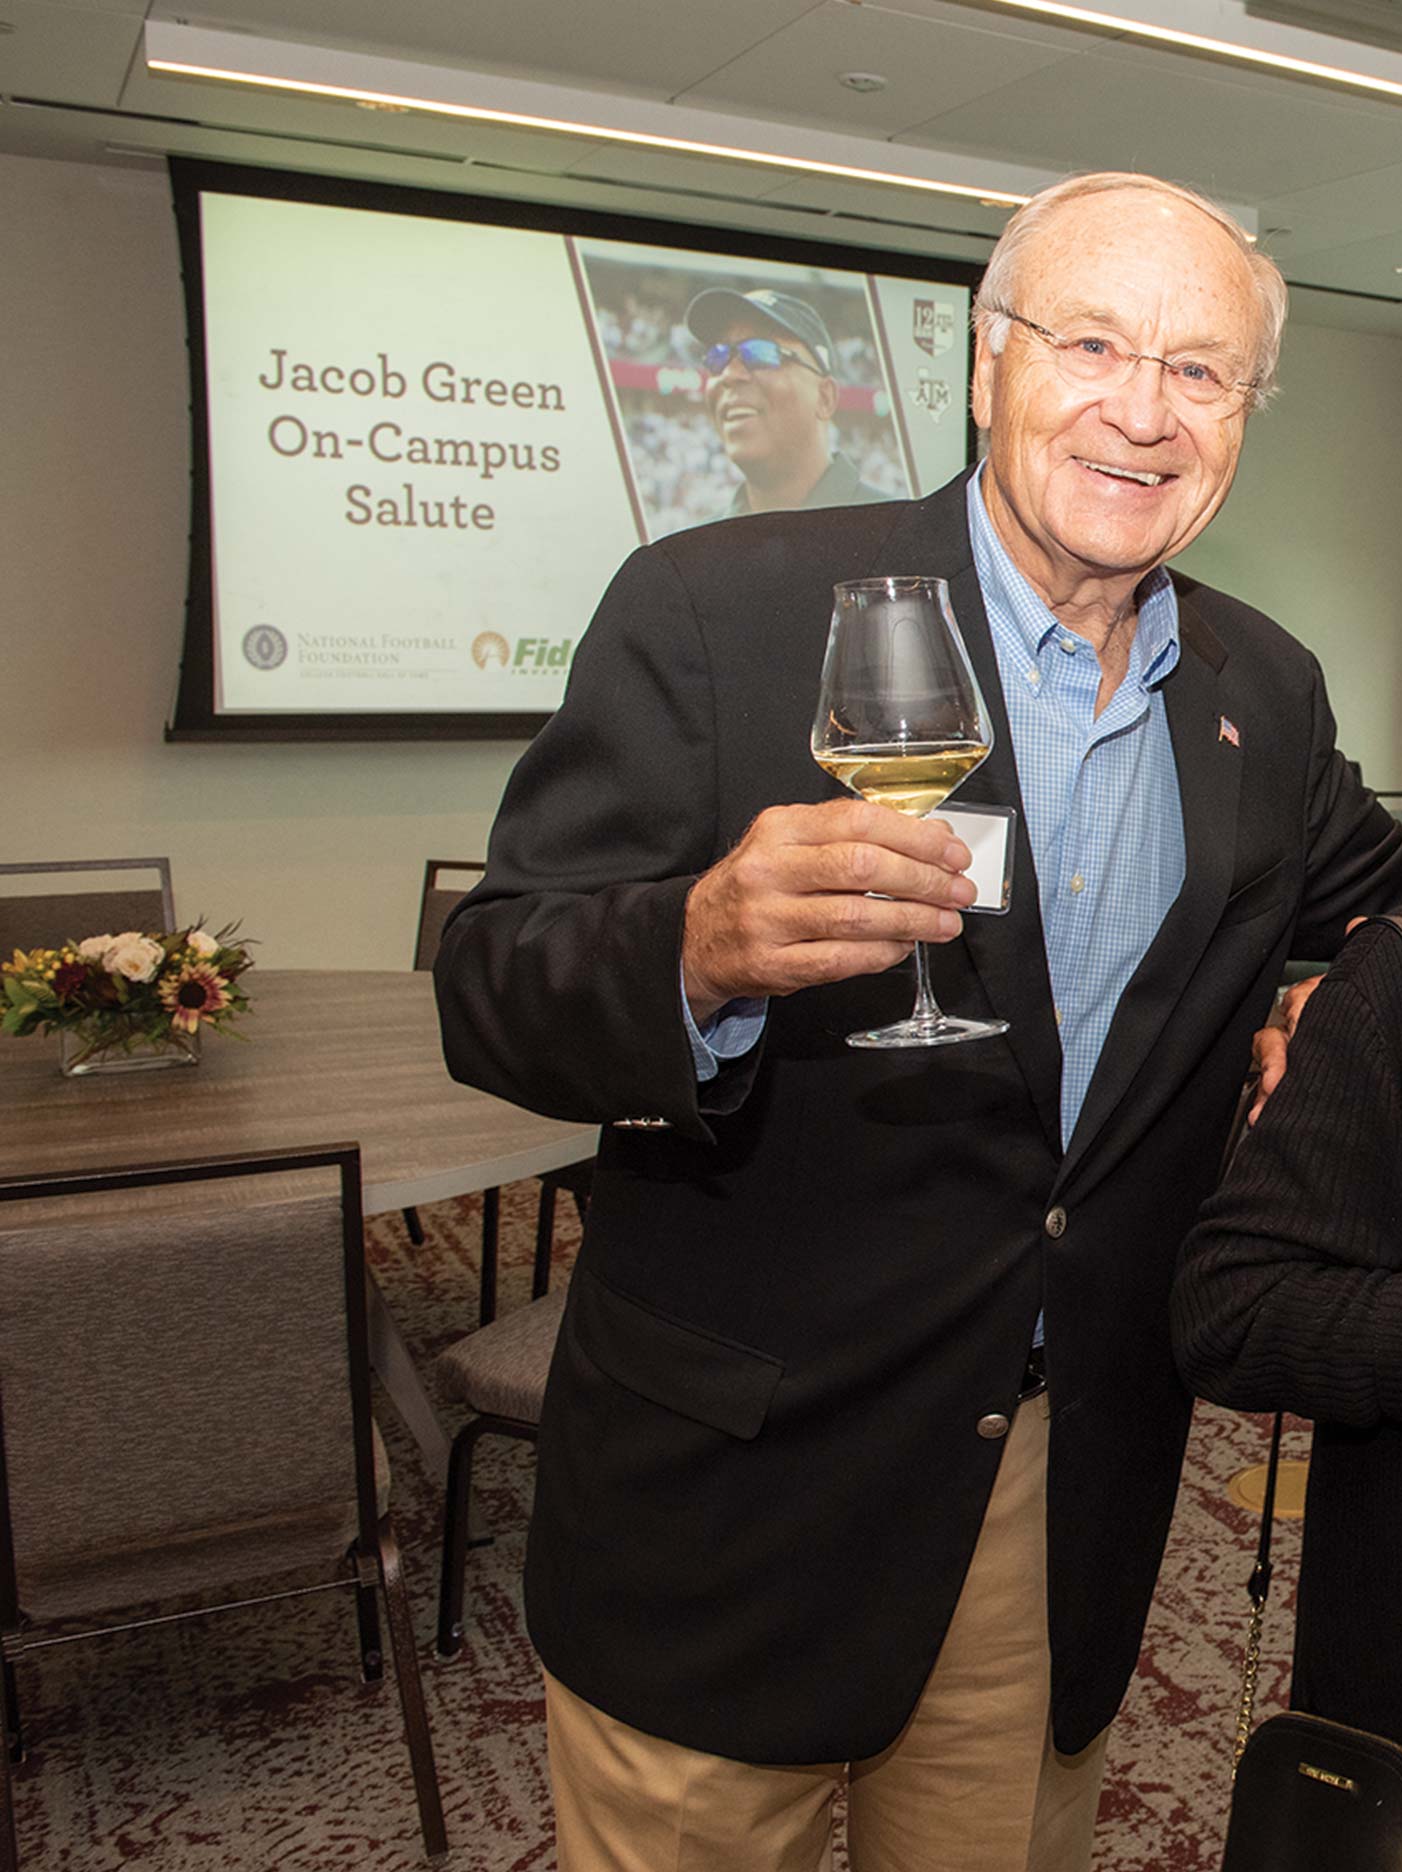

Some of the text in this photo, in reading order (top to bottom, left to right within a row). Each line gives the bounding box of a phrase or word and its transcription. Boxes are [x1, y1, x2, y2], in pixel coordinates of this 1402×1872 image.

[257, 347, 567, 412] Jacob Green
[267, 413, 562, 481] On-Campus
[344, 482, 496, 532] Salute
